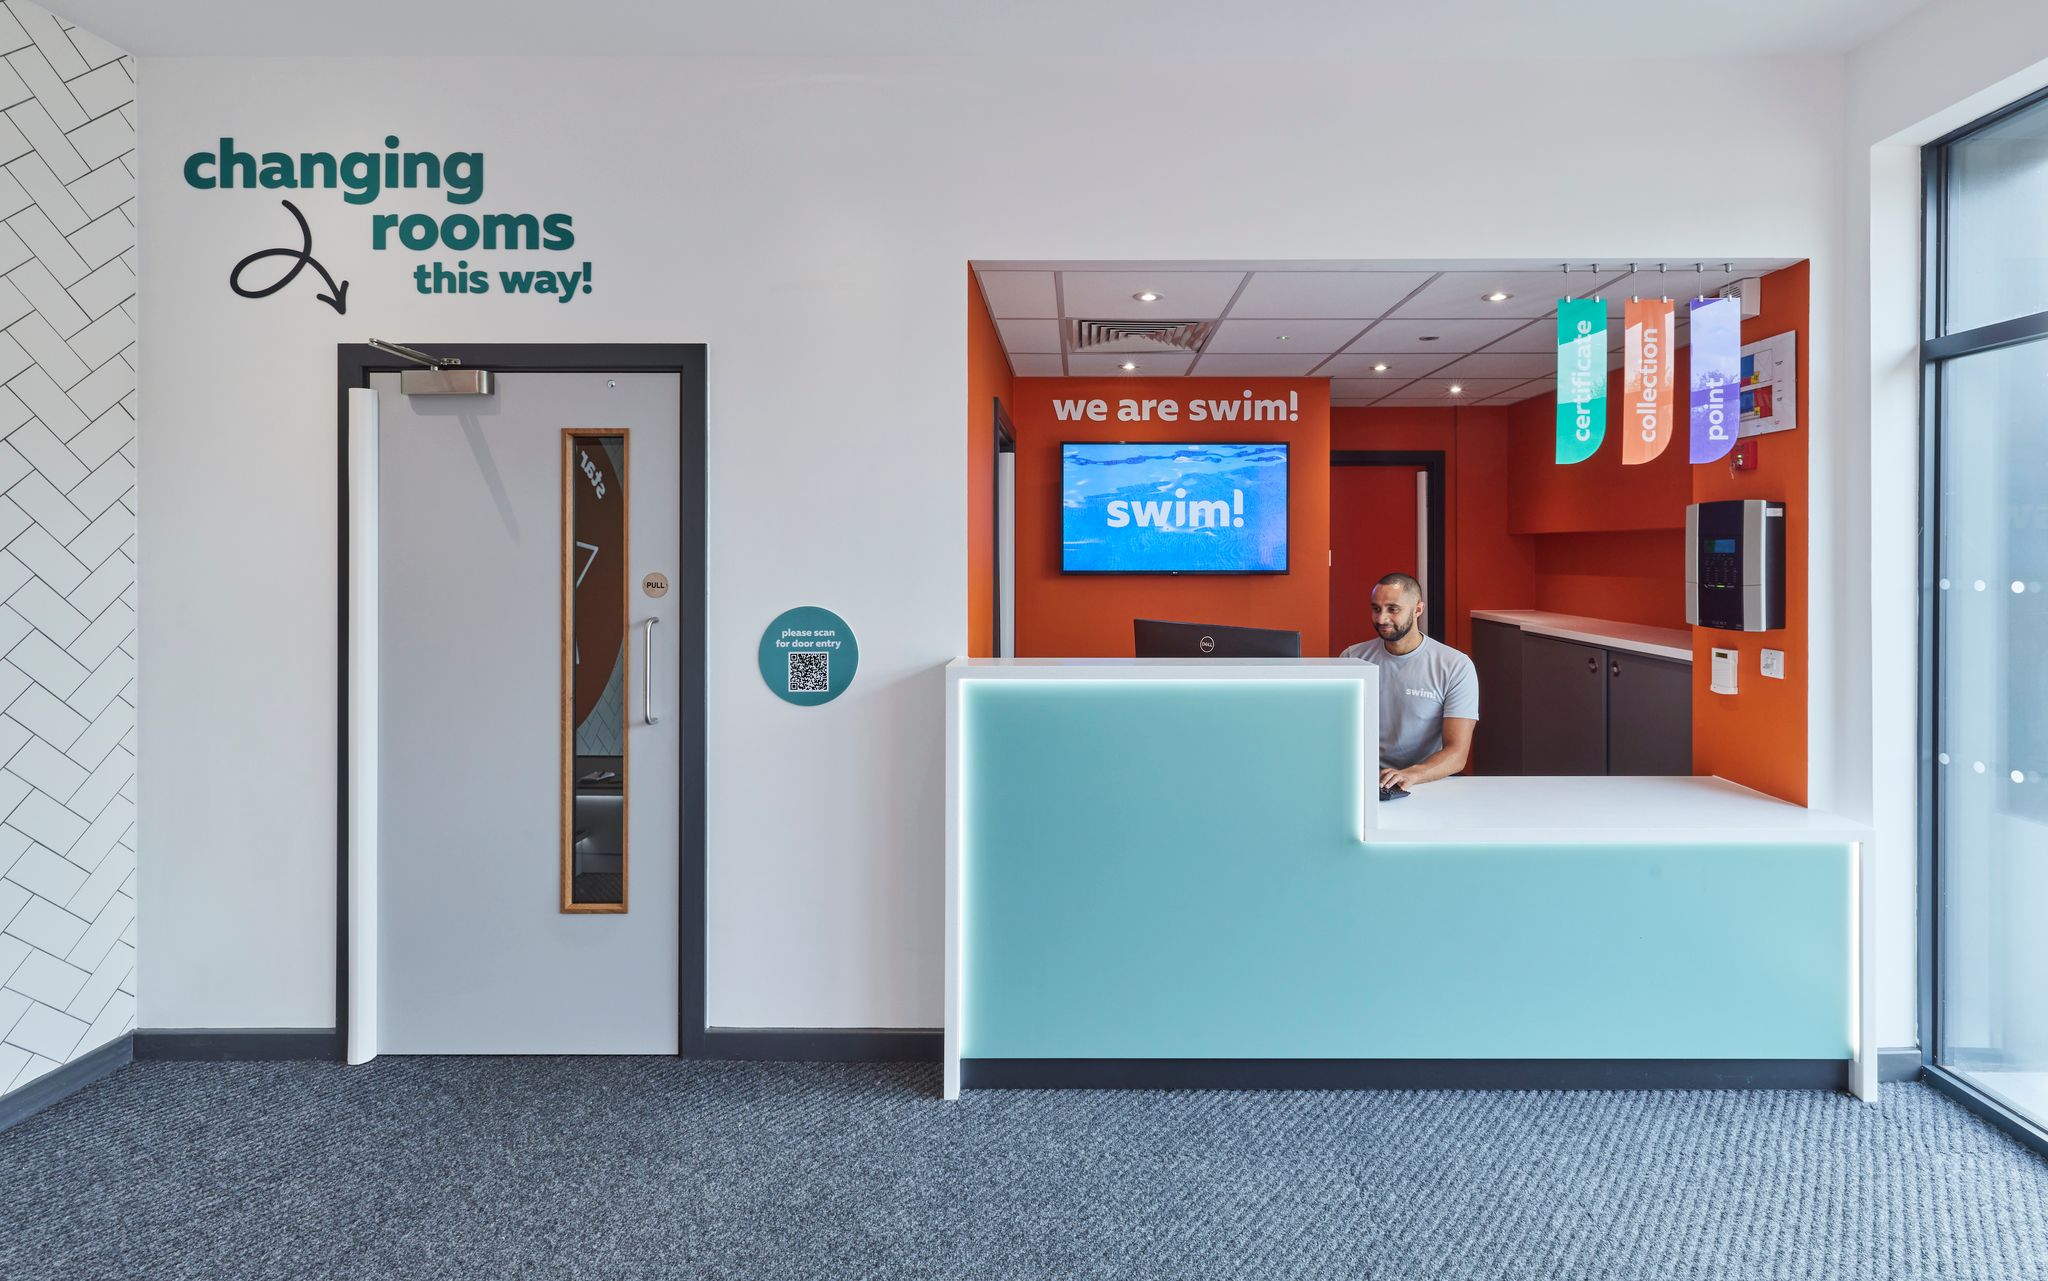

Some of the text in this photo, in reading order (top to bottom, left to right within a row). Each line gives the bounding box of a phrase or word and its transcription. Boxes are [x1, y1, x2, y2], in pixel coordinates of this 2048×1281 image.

[183, 135, 484, 205] changing
[372, 213, 575, 251] rooms
[413, 260, 592, 303] this way!
[1573, 320, 1592, 442] certificate
[1636, 328, 1658, 443] collection
[1052, 389, 1299, 422] we are swim!
[1704, 377, 1729, 441] point
[1107, 487, 1244, 528] swim!
[646, 581, 665, 589] PULL
[775, 640, 841, 649] for door entry
[781, 628, 812, 639] please
[1405, 687, 1437, 699] swim!
